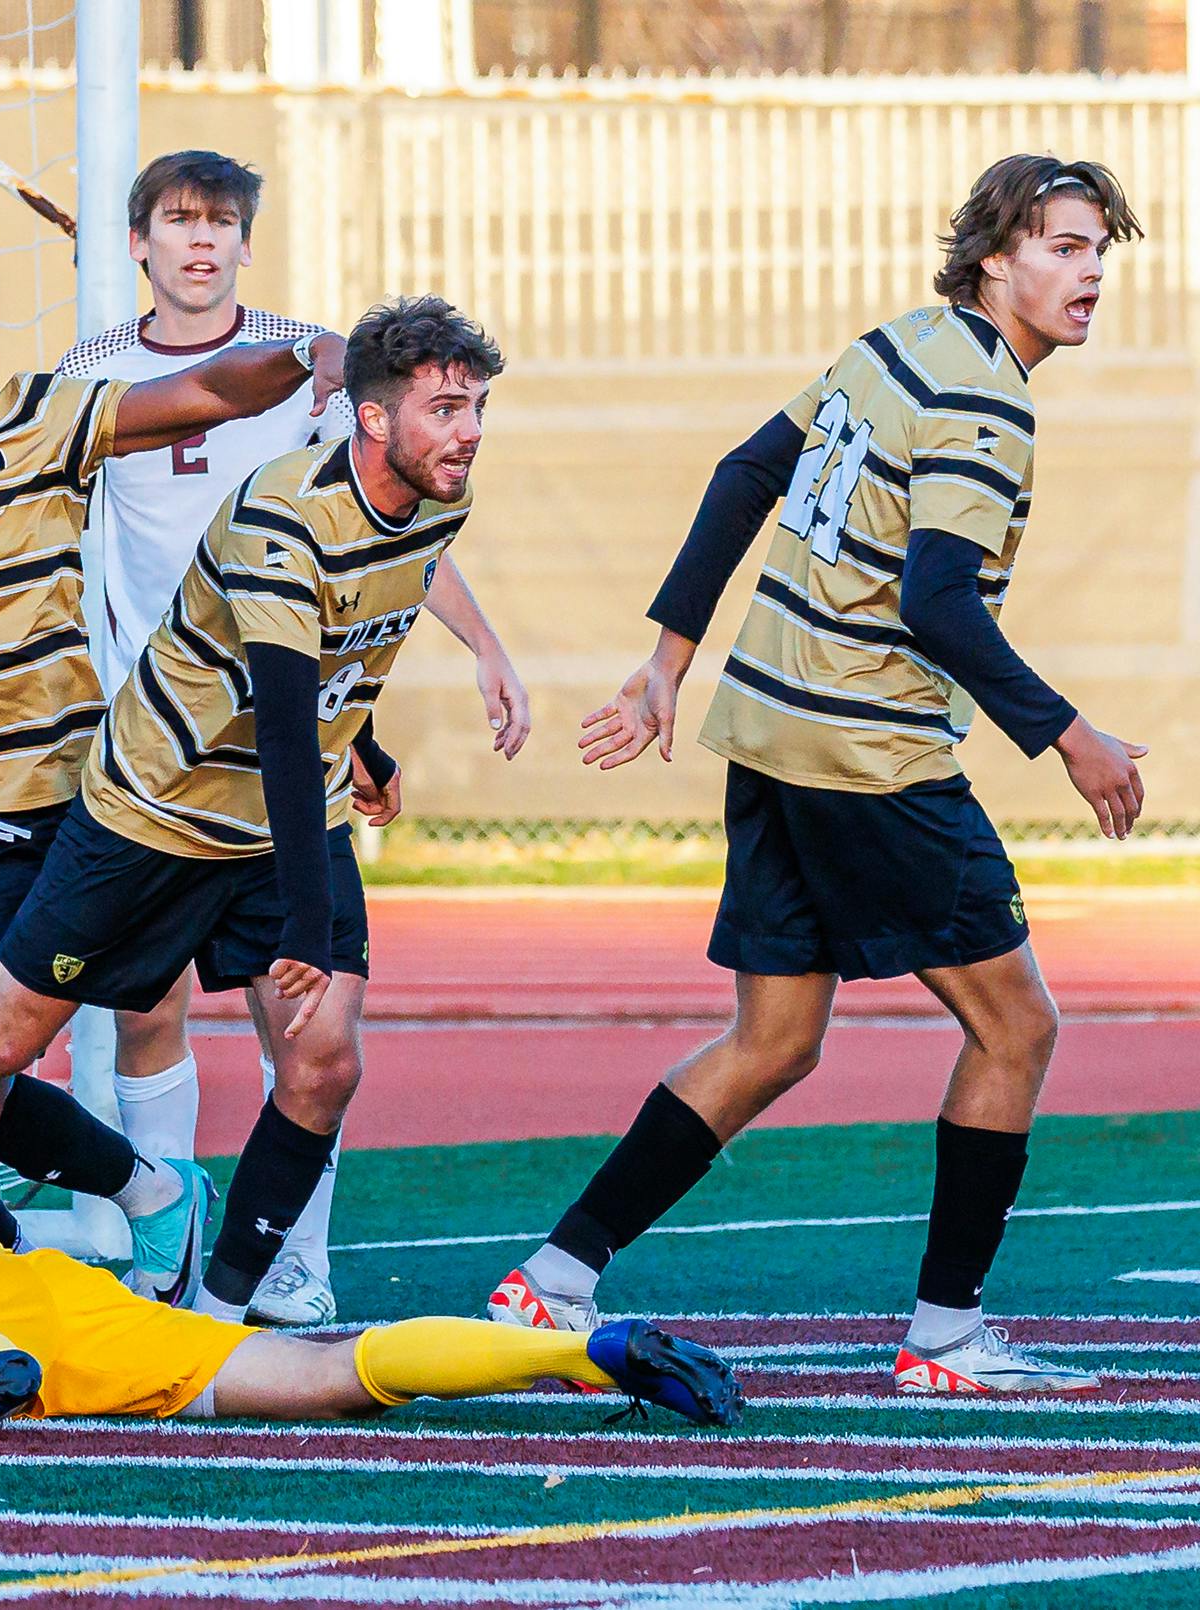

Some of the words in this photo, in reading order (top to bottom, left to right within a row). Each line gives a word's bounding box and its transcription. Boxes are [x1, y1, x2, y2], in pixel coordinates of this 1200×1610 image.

[172, 432, 209, 476] 2
[335, 604, 417, 658] OLES
[318, 659, 367, 724] 8
